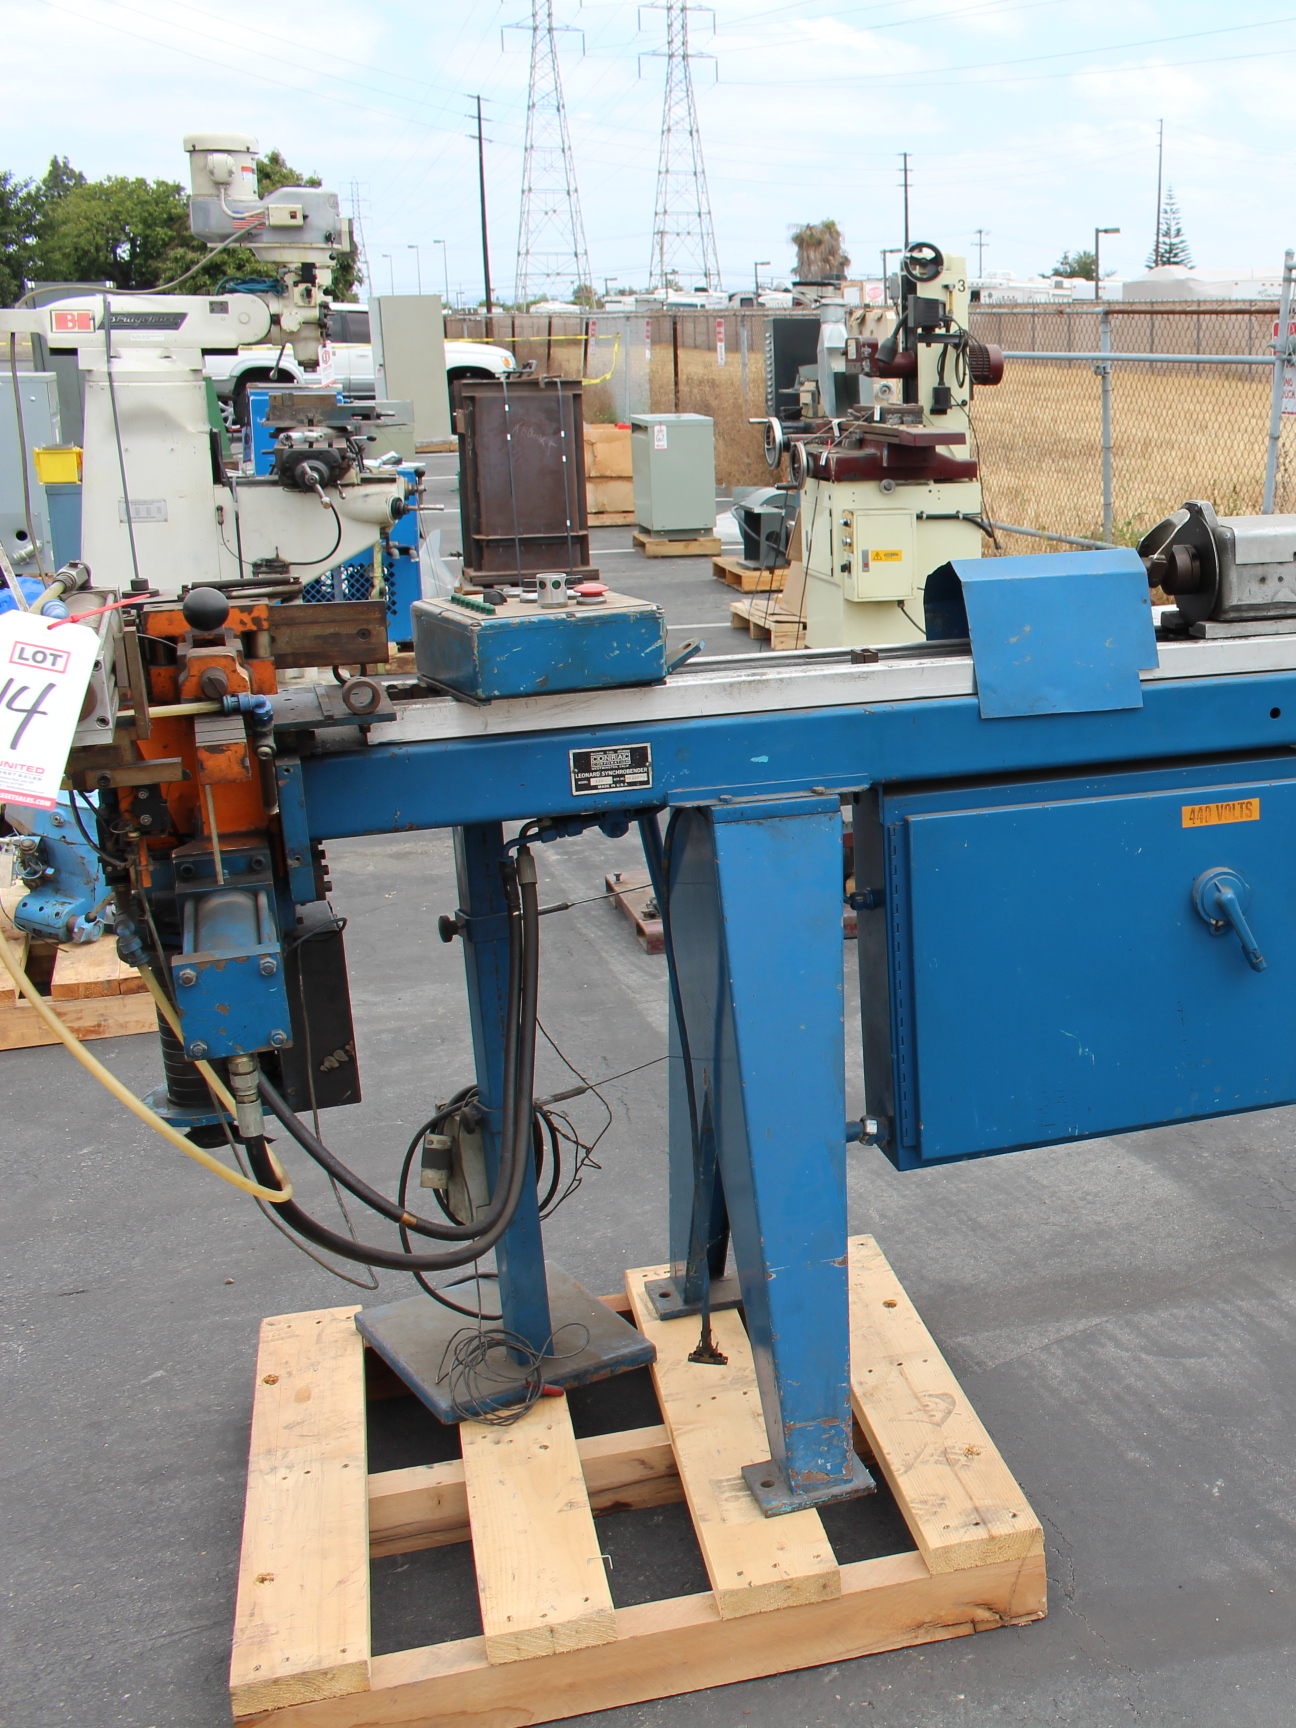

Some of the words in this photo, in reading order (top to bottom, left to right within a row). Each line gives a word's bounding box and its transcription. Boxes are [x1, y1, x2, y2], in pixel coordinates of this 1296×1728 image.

[957, 279, 966, 292] 3
[17, 646, 64, 667] LOT
[0, 760, 45, 774] NITED
[575, 771, 600, 779] LEONARD
[0, 792, 52, 806] SSETSALES.COM
[1189, 805, 1212, 825] 440
[1215, 800, 1253, 822] VOLTS
